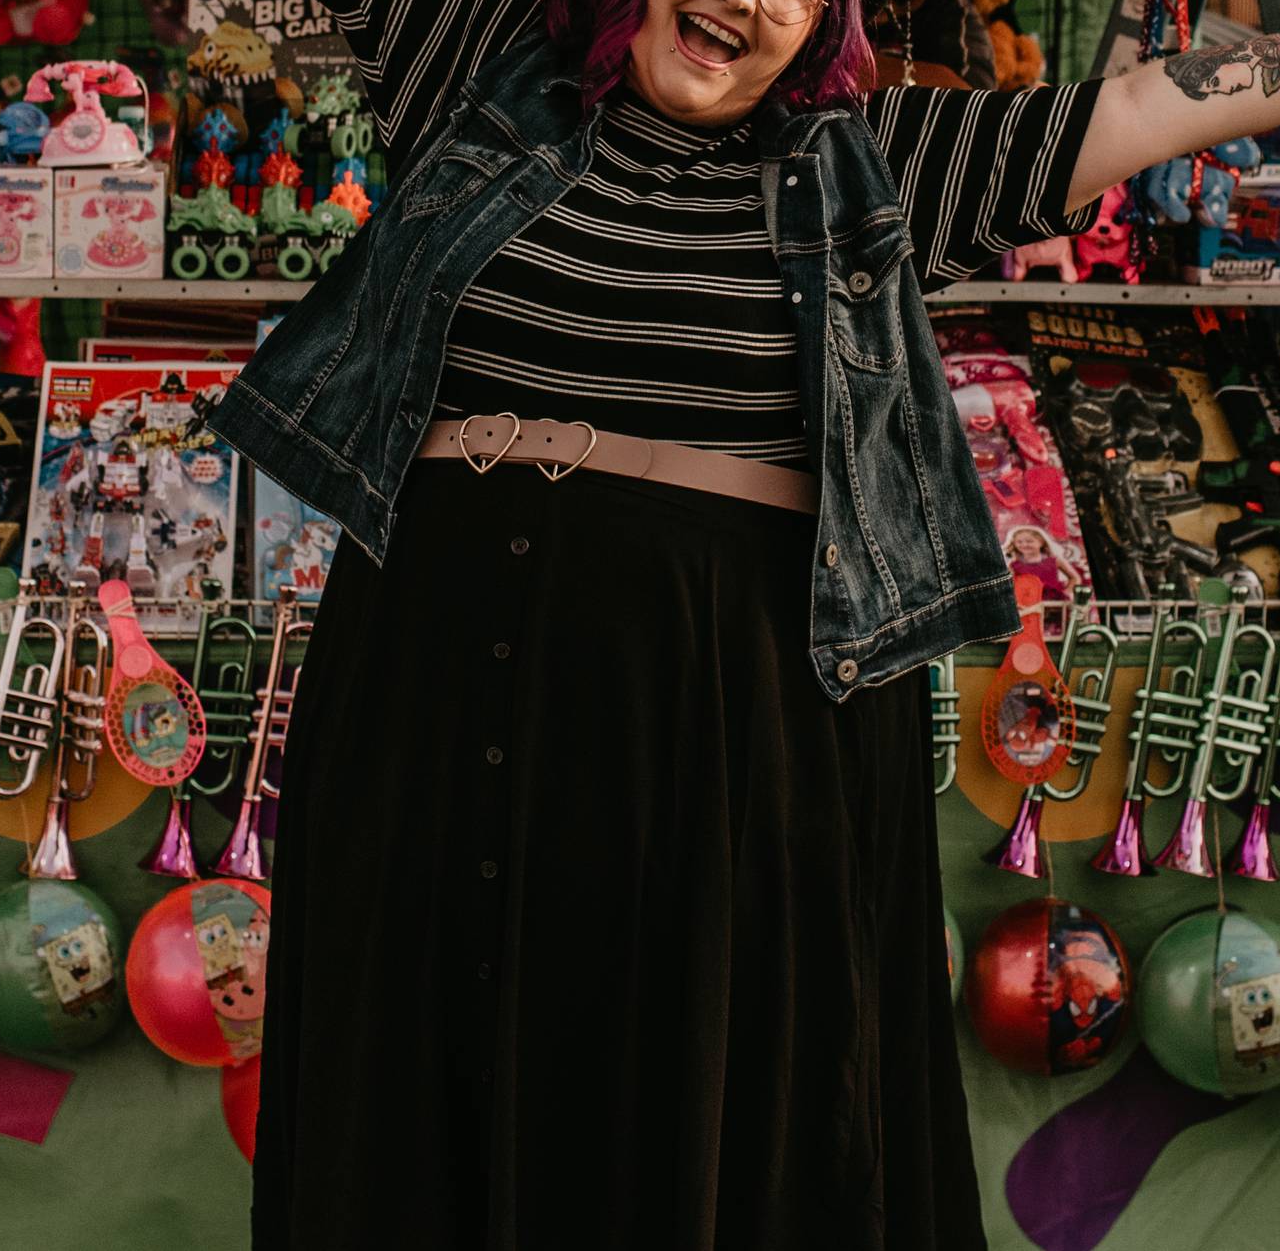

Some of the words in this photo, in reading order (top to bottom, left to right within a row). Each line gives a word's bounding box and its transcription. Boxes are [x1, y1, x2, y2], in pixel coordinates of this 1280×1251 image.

[285, 16, 332, 38] CAR
[1211, 258, 1276, 279] ROBOT
[1027, 310, 1144, 347] SQUADS
